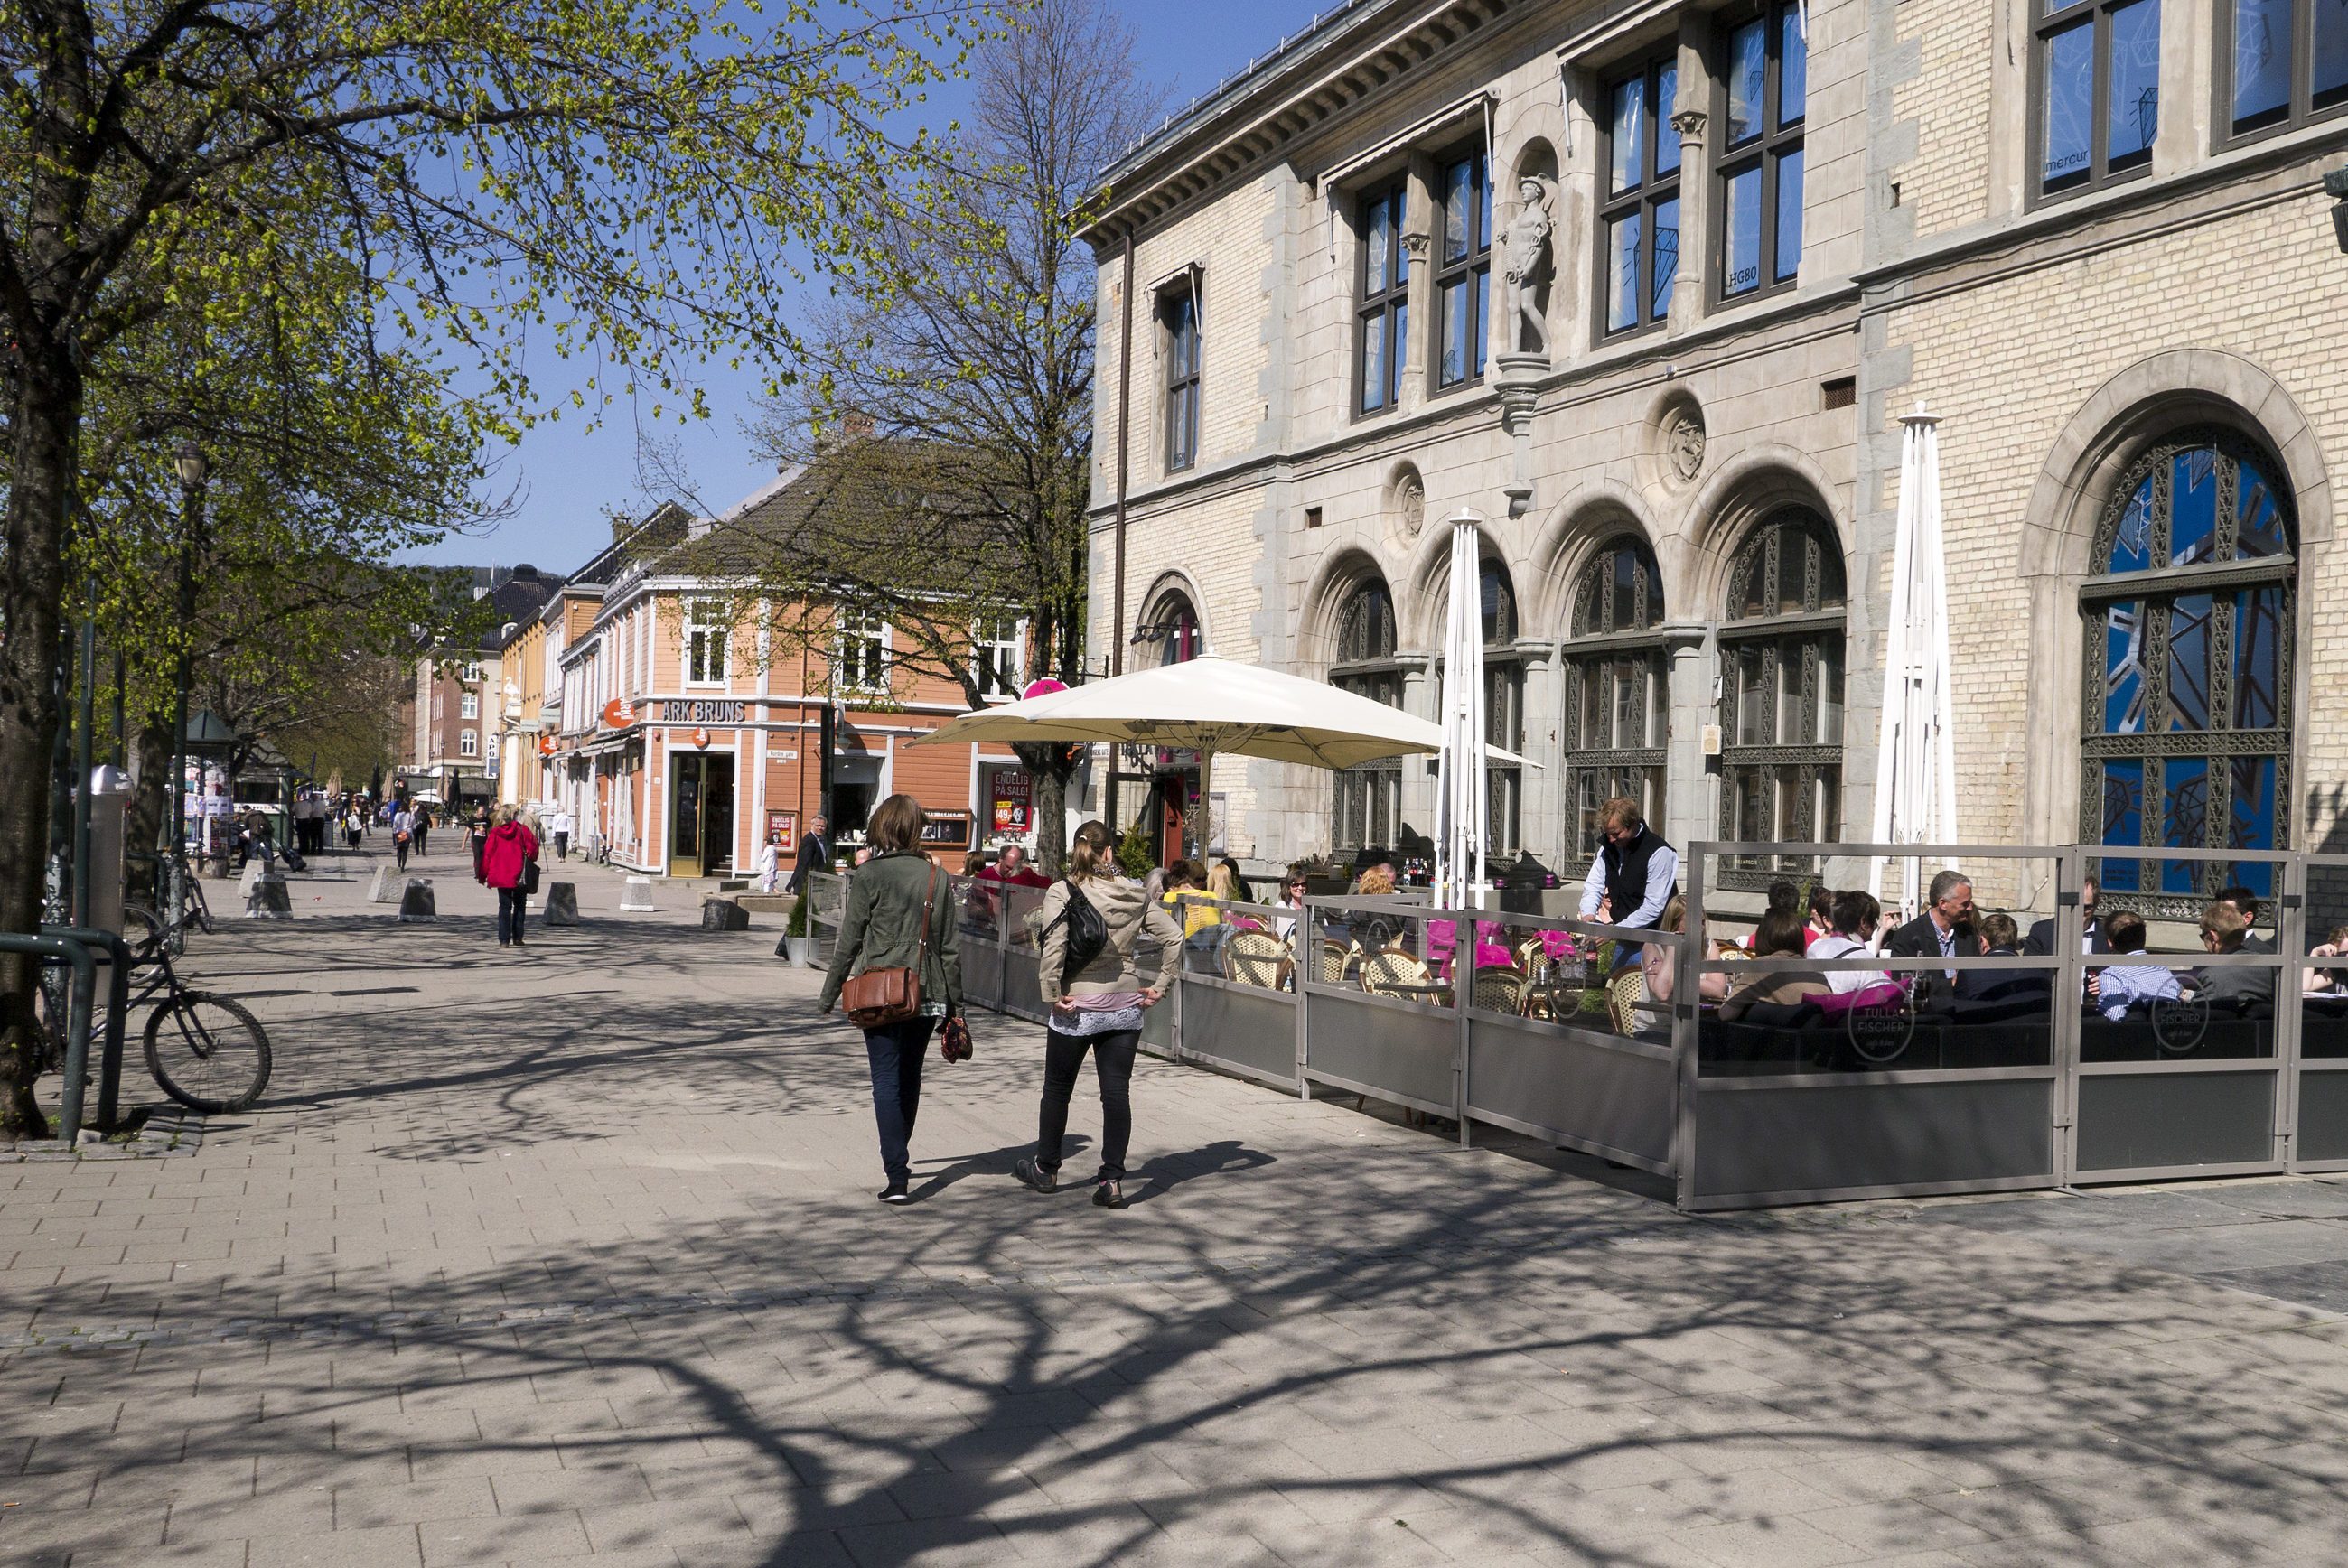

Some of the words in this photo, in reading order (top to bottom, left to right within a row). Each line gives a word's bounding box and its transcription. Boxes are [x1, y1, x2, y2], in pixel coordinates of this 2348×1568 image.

[2045, 150, 2088, 173] mercur
[1729, 266, 1757, 287] HG80
[663, 701, 692, 721] ARK
[694, 701, 745, 722] BRUNS
[996, 774, 1028, 786] ENDELIG
[995, 785, 1006, 796] PÅ
[1006, 786, 1028, 796] SALG!
[2166, 1001, 2195, 1011] TULLA
[1865, 1007, 1899, 1019] TULLA
[2161, 1013, 2202, 1025] FISCHER
[1857, 1022, 1905, 1033] FISCHER
